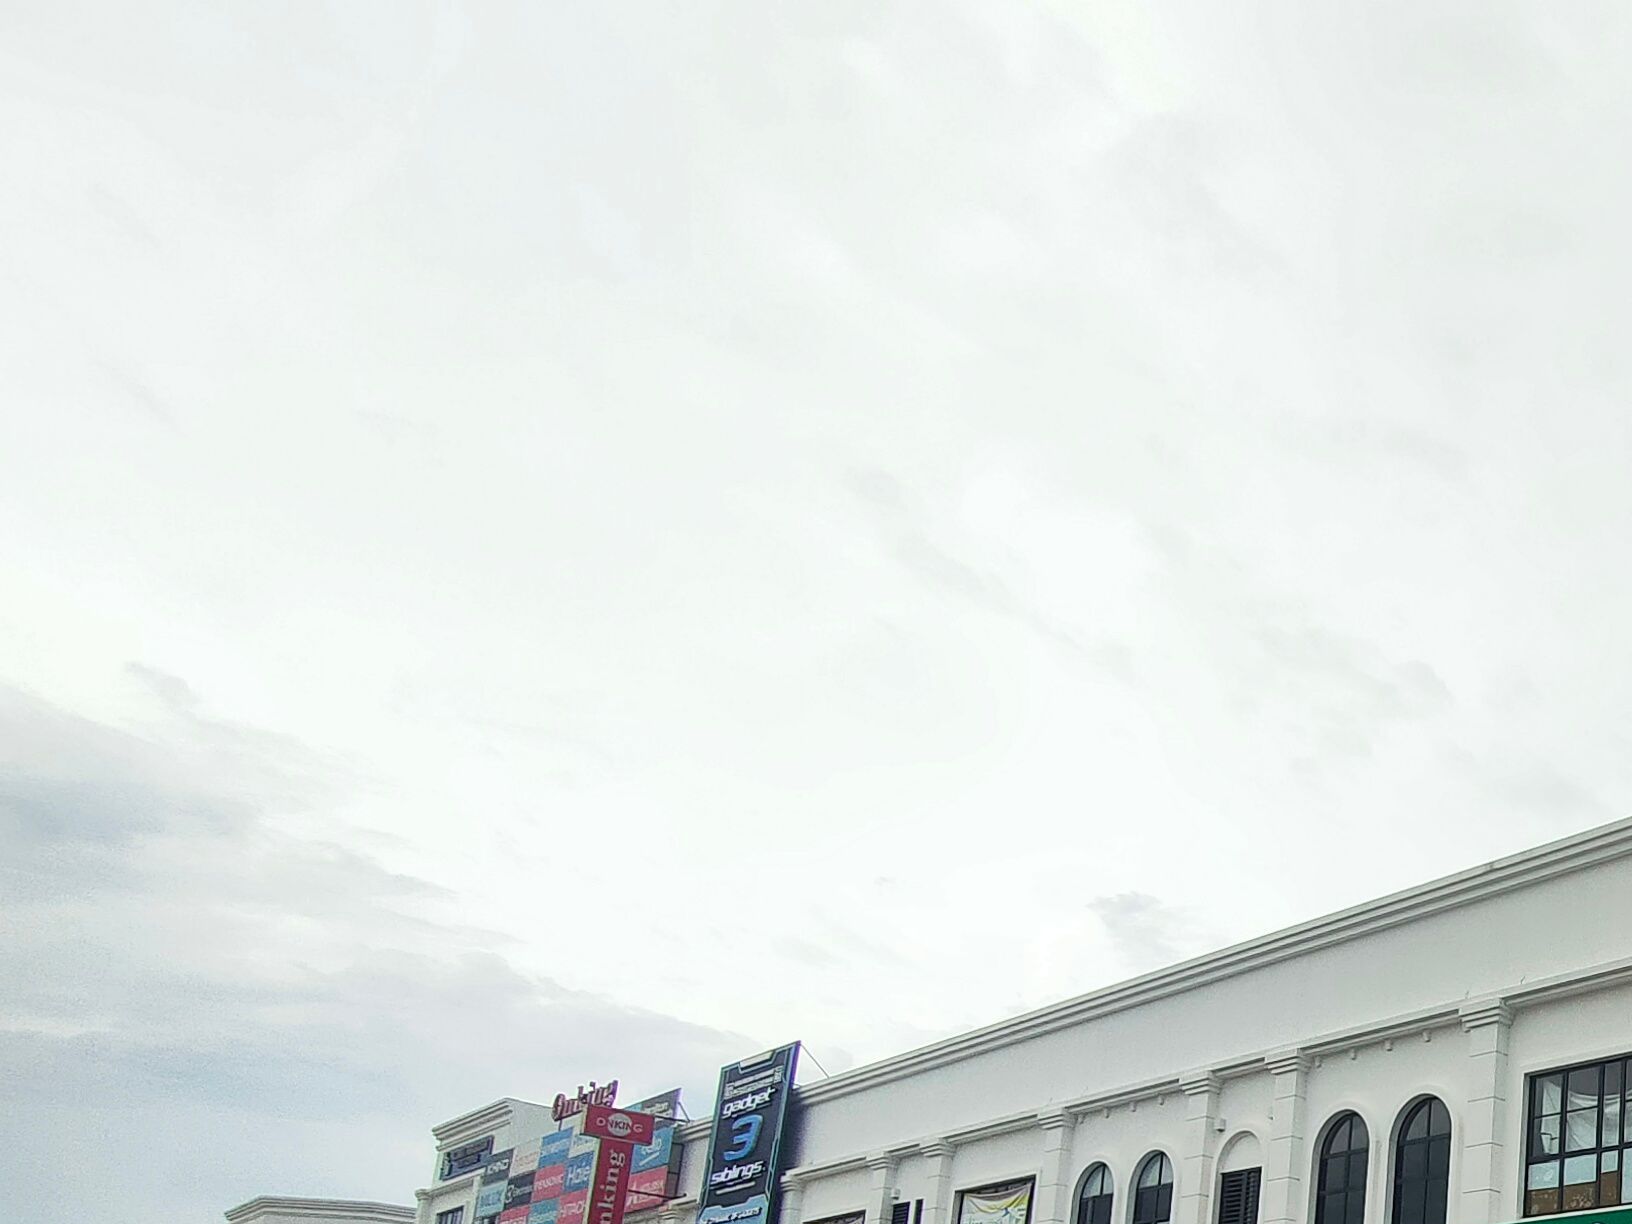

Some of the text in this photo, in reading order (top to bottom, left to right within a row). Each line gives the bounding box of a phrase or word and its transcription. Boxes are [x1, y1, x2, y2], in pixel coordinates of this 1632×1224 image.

[722, 1088, 776, 1120] gadget
[596, 1116, 644, 1134] ONKING
[723, 1114, 764, 1162] 3
